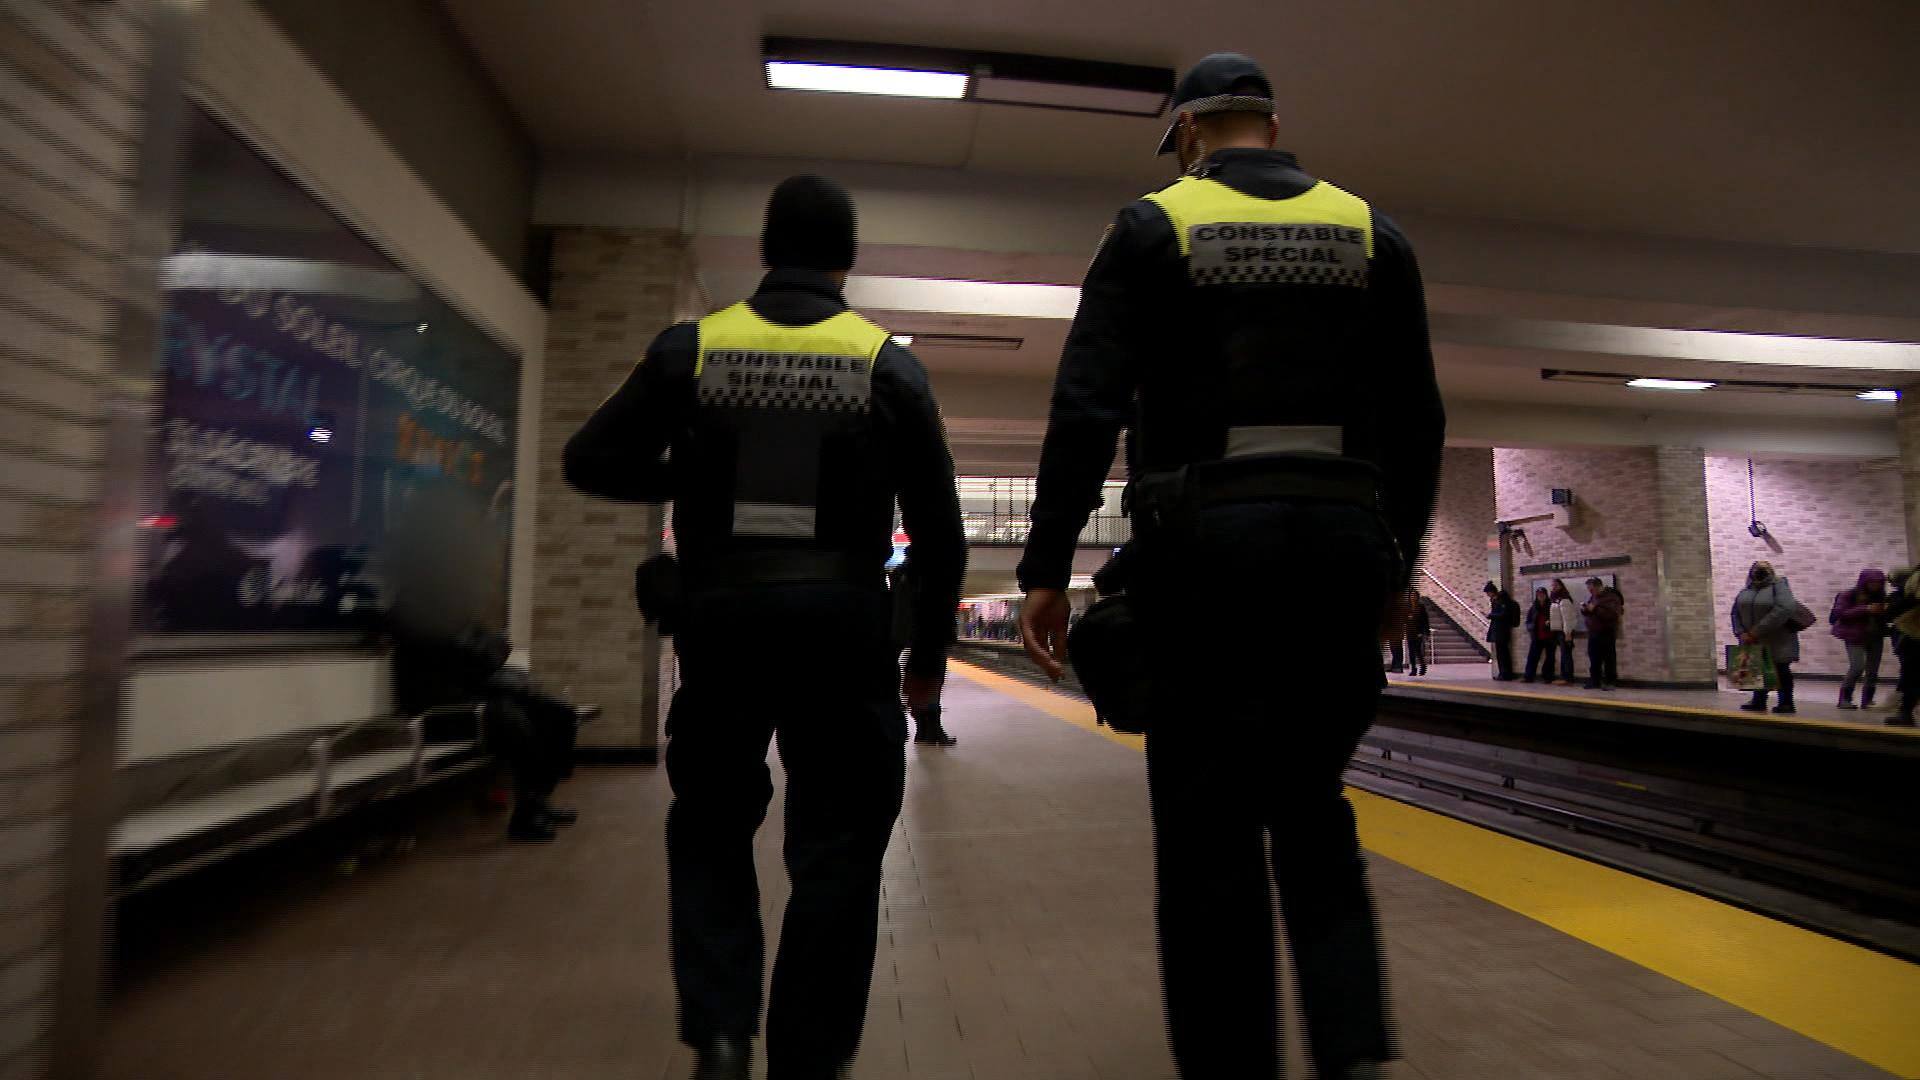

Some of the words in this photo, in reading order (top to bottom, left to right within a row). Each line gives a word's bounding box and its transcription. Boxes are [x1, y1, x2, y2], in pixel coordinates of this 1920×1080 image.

[1196, 225, 1364, 244] CONSTABLE
[1223, 241, 1342, 264] SPÉCIAL
[273, 294, 362, 368] SOLEIL
[706, 351, 867, 373] CONSTABLE
